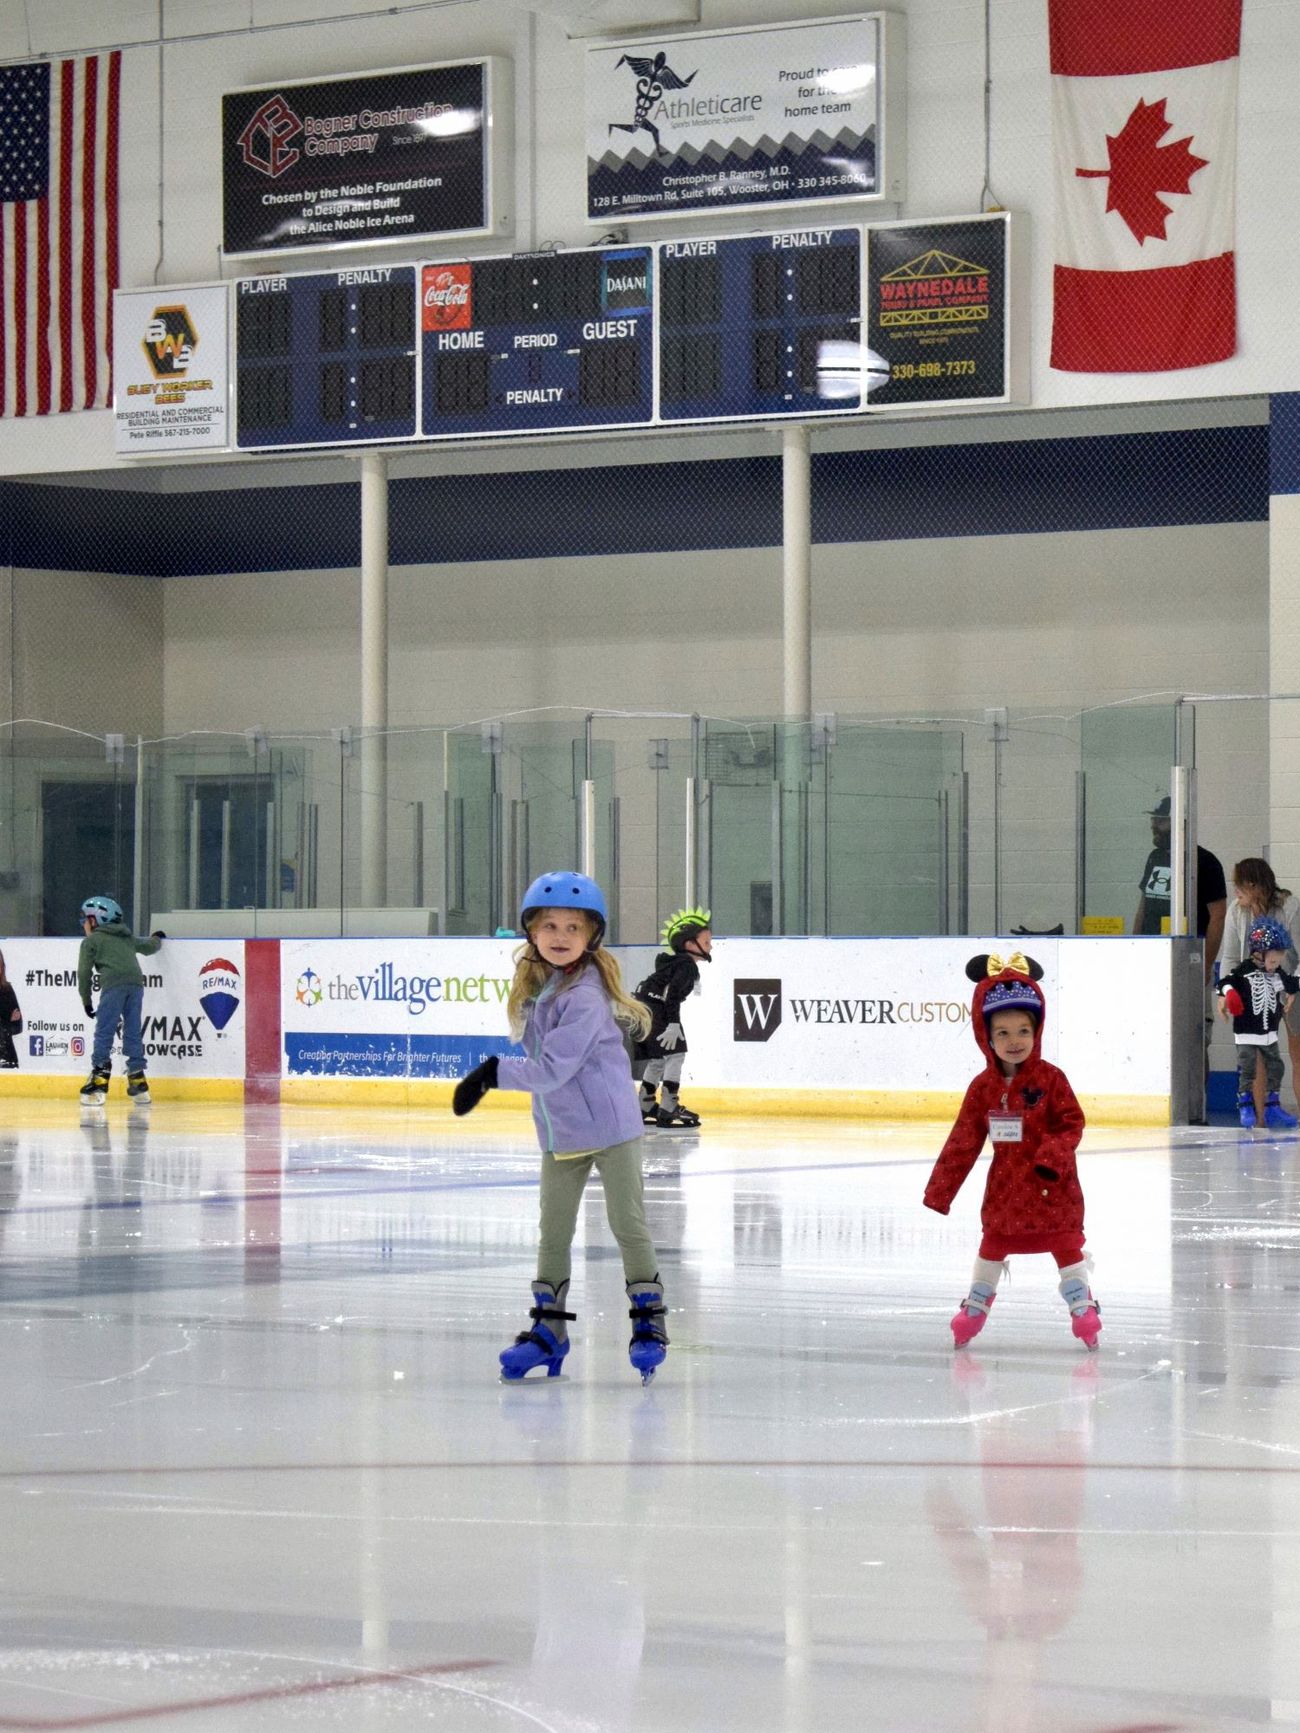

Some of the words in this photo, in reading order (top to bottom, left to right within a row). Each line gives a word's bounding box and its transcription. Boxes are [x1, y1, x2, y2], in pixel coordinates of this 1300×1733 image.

[779, 68, 814, 81] Proud
[798, 86, 815, 98] for
[654, 95, 762, 120] Athleticare
[784, 105, 818, 117] home
[821, 102, 851, 114] team
[304, 114, 357, 138] Bogner
[359, 102, 453, 128] Construction
[304, 133, 379, 156] Company
[662, 173, 717, 187] Christopher
[719, 171, 728, 181] B.
[730, 170, 767, 180] Ranney,
[770, 166, 791, 176] M.D.
[261, 193, 303, 206] Chosen
[304, 190, 318, 203] by
[320, 187, 338, 199] the
[340, 182, 374, 197] Noble
[376, 176, 442, 193] Foundation
[593, 197, 610, 207] 128
[612, 196, 620, 205] E.
[622, 193, 663, 204] Milltown
[681, 188, 704, 199] Suite
[729, 183, 771, 194] Wooster,
[772, 180, 790, 191] OH
[797, 178, 817, 189] 330
[302, 207, 314, 217] to
[315, 202, 350, 217] Design
[352, 200, 371, 212] and
[373, 197, 400, 209] Build
[289, 223, 306, 235] the
[308, 219, 333, 232] Alice
[335, 216, 365, 230] Noble
[367, 215, 382, 227] Ice
[383, 213, 414, 225] Arena
[665, 241, 717, 259] PLAYER
[772, 231, 832, 250] PENALTY
[241, 279, 287, 295] PLAYER
[338, 269, 392, 286] PENALTY
[606, 275, 647, 294] DASANI
[880, 276, 989, 299] WAYNEDALE
[438, 332, 484, 350] HOME
[513, 333, 558, 349] PERIOD
[583, 319, 637, 341] GUEST
[892, 360, 976, 380] 330-698-7373
[162, 380, 213, 393] WORKER
[506, 388, 563, 406] PENALTY
[117, 409, 159, 419] RESIDENTIAL
[161, 408, 176, 417] AND
[178, 406, 224, 416] COMMERCIAL
[128, 417, 160, 427] BUILDING
[161, 414, 212, 424] MAINTENANCE
[129, 431, 144, 439] Pete
[203, 977, 236, 990] RE/MAX
[737, 994, 778, 1030] W
[28, 1020, 57, 1031] Follow
[60, 1022, 70, 1031] us
[73, 1023, 84, 1031] on
[142, 1043, 203, 1059] OWCASE
[333, 1050, 381, 1064] Partnerships
[383, 1051, 395, 1062] For
[397, 1051, 430, 1063] Brighter
[431, 1052, 461, 1063] Futures
